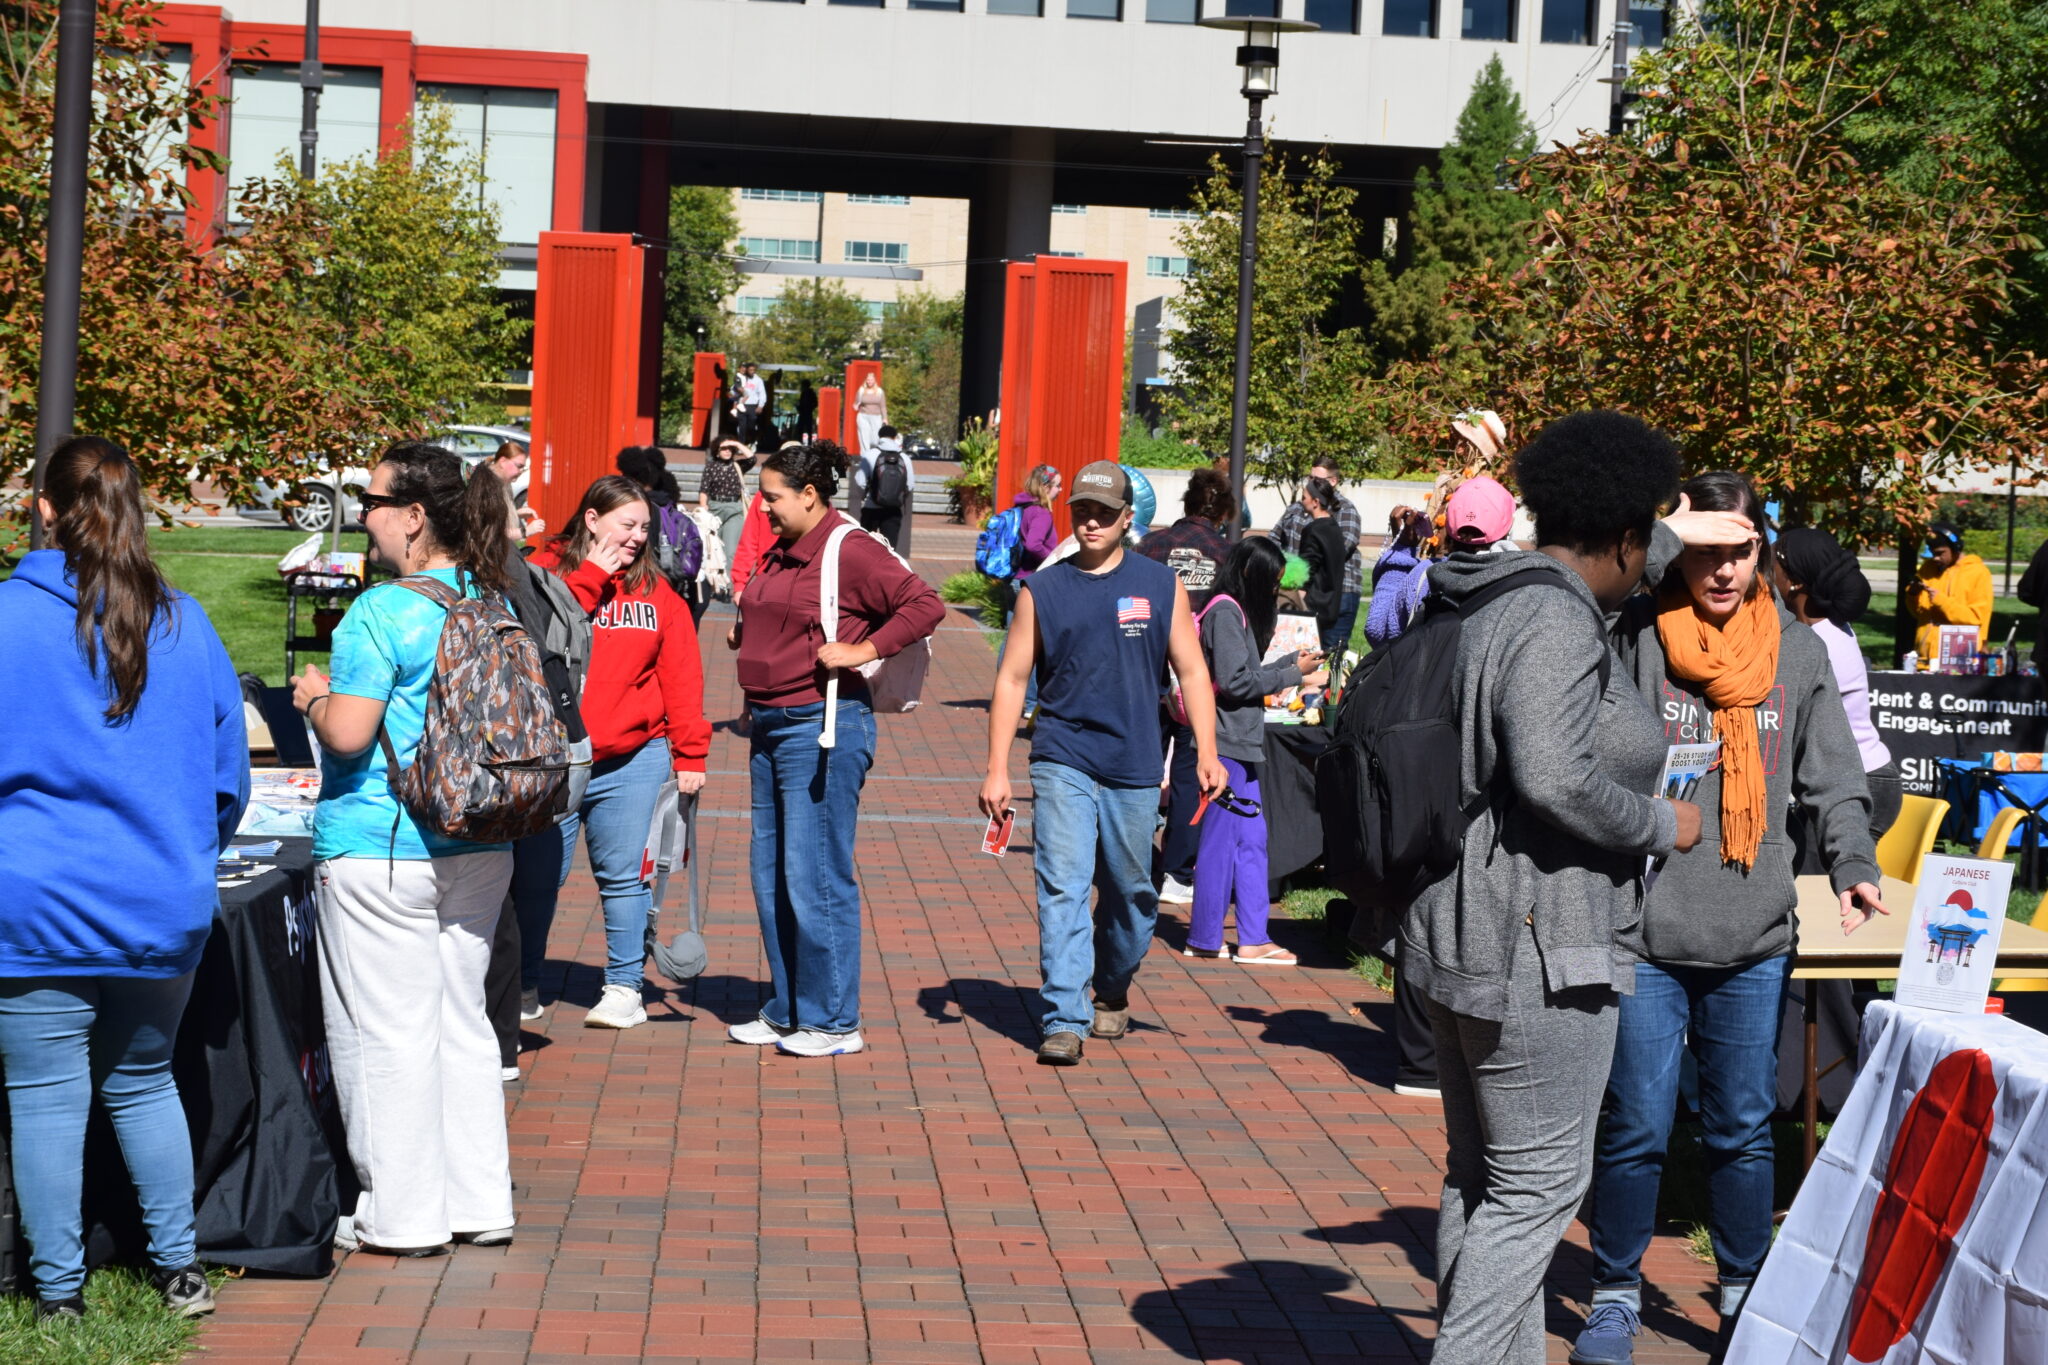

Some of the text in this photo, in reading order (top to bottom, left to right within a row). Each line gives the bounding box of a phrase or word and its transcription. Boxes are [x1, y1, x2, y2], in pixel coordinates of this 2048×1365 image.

[592, 600, 658, 632] CLAIR
[1919, 692, 1934, 709] &
[1671, 759, 1691, 767] BOOST
[1942, 866, 1991, 881] JAPANESE
